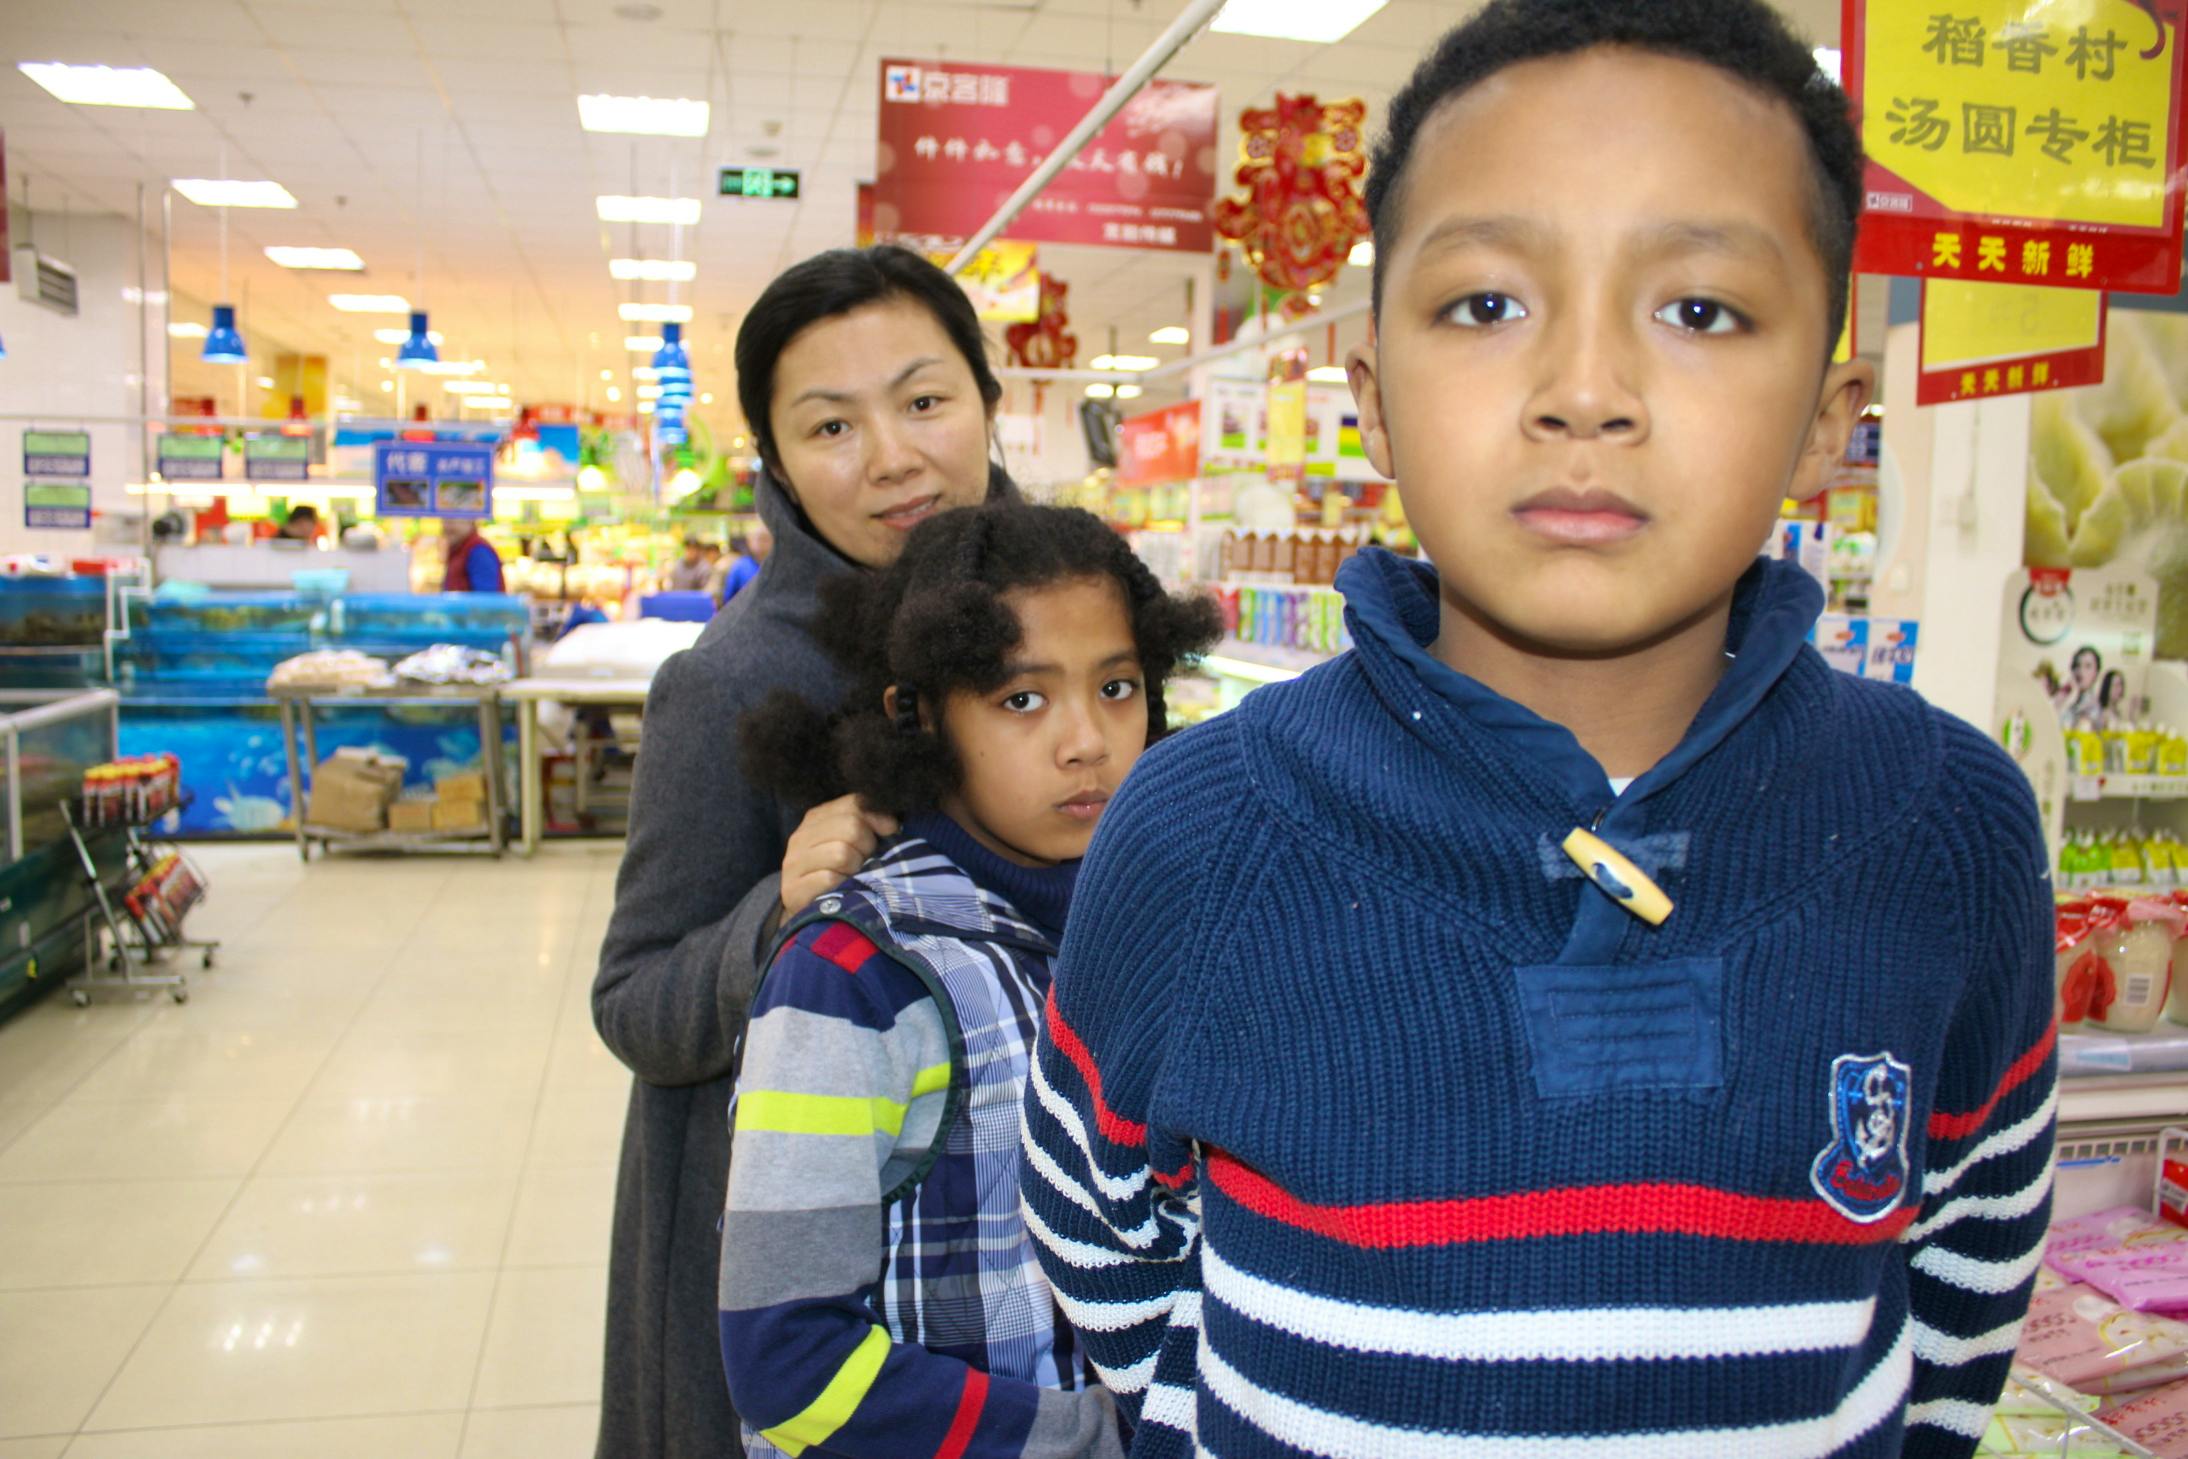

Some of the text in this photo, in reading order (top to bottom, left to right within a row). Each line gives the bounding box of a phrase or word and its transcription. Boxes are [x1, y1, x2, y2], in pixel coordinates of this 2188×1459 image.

[1922, 13, 2127, 81] 稻香村
[1886, 97, 2156, 169] 汤圆专柜
[1932, 232, 2094, 279] 天天新鲜
